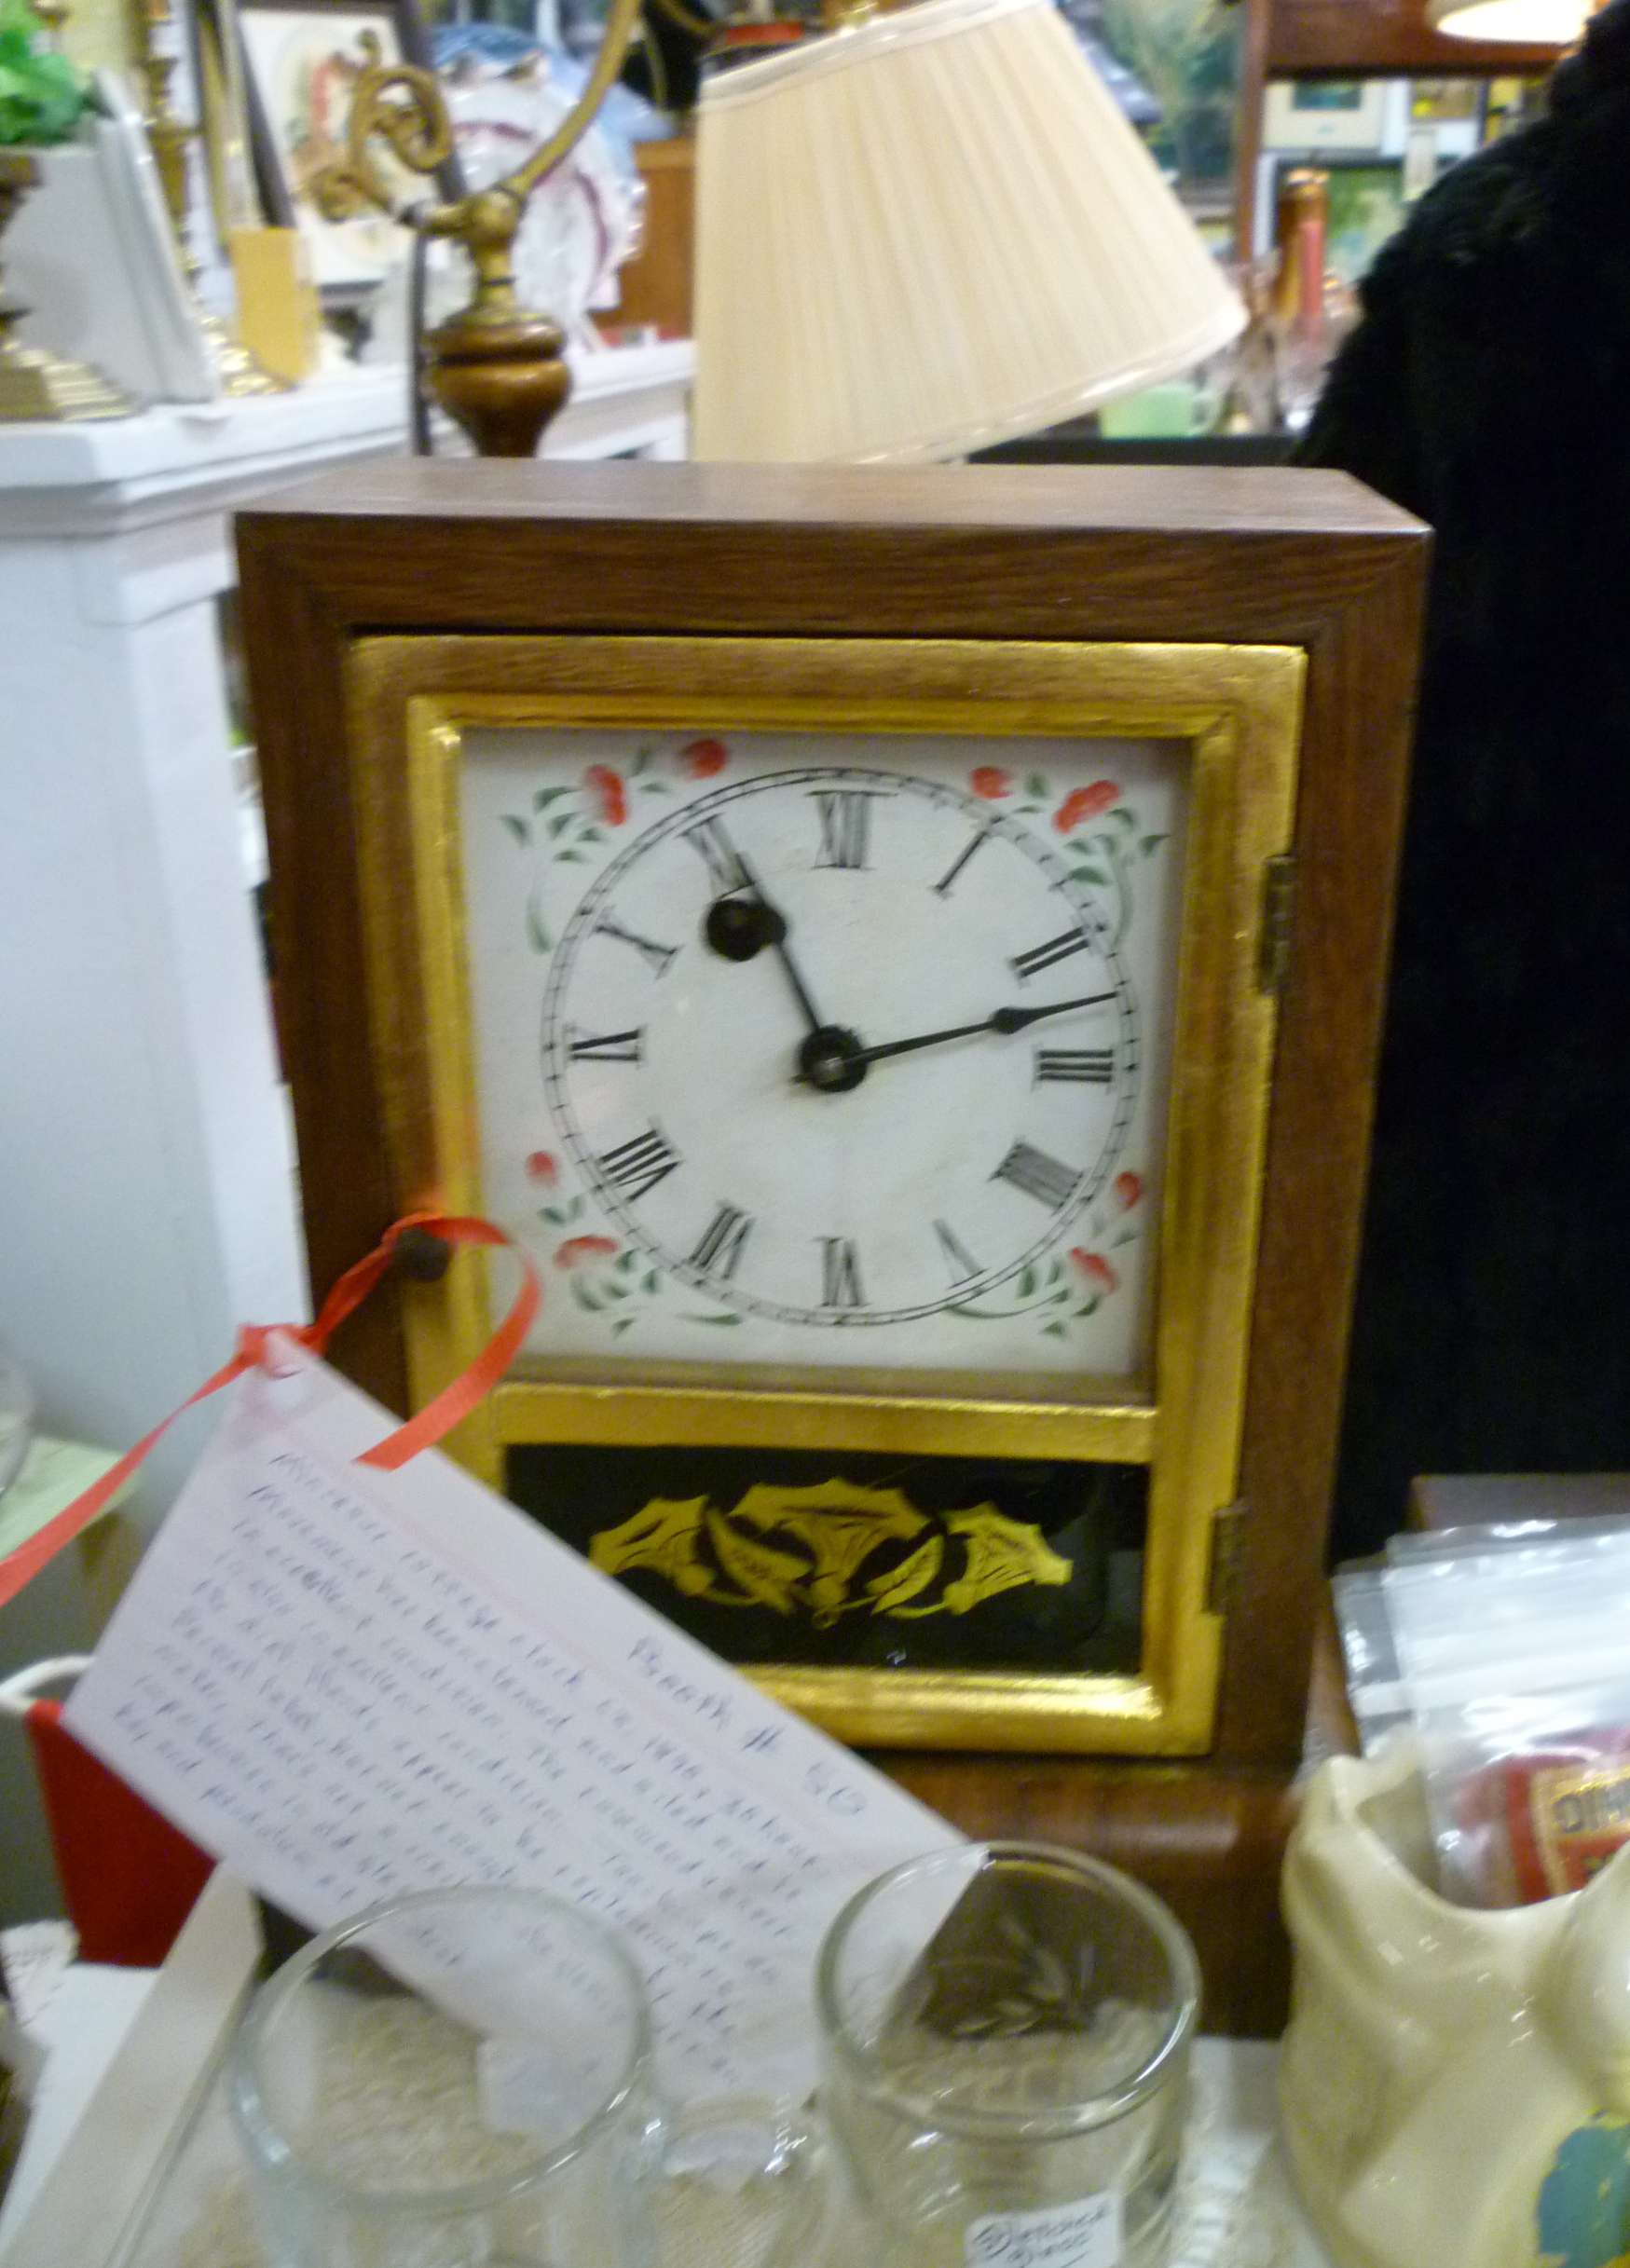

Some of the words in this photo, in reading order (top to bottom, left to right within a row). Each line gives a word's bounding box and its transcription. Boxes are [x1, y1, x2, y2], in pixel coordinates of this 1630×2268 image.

[1032, 1045, 1116, 1092] III
[623, 1632, 743, 1733] Booth
[735, 1712, 789, 1768] #
